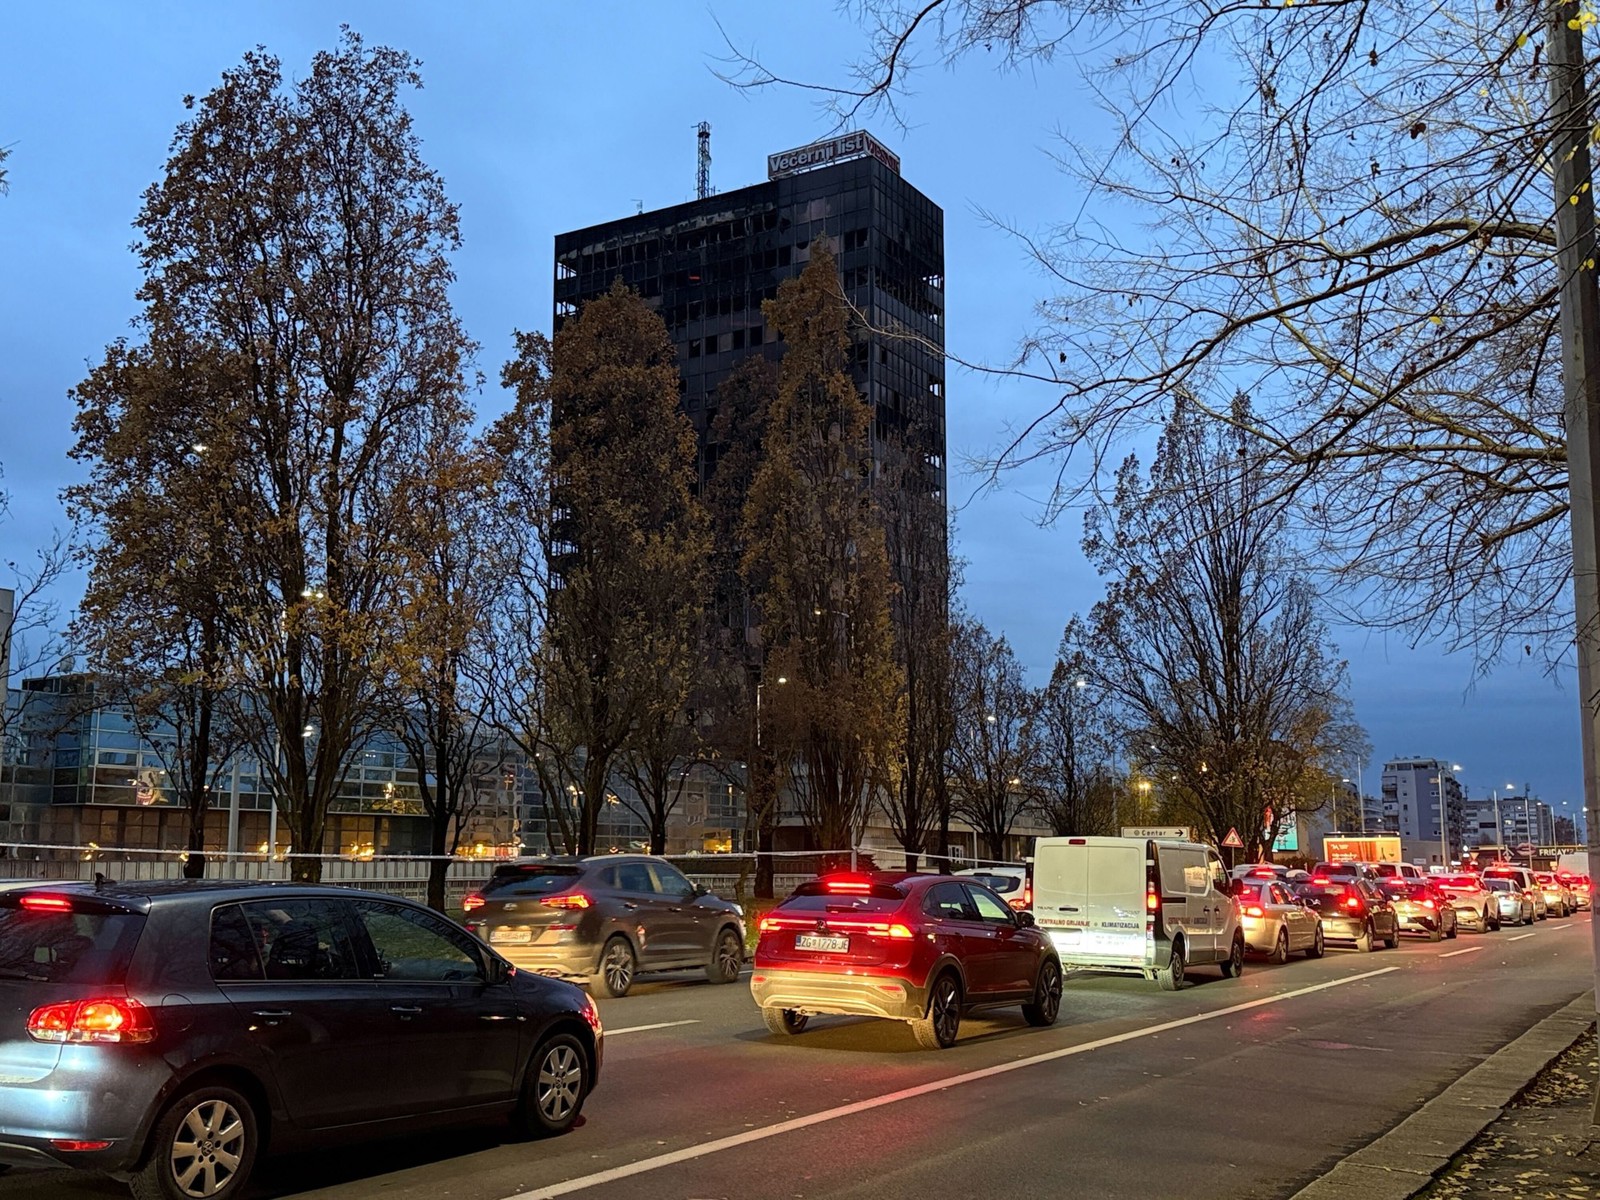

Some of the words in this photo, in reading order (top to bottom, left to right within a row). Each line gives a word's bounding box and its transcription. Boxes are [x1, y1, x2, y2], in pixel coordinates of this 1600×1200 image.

[770, 143, 835, 172] Večernji
[838, 135, 863, 155] list
[1141, 828, 1167, 836] Centar
[1038, 918, 1066, 926] CENTRALNO
[1066, 919, 1090, 927] GRIJANJE
[1101, 921, 1140, 929] KLIMATIZACIJA
[801, 937, 812, 948] ZG
